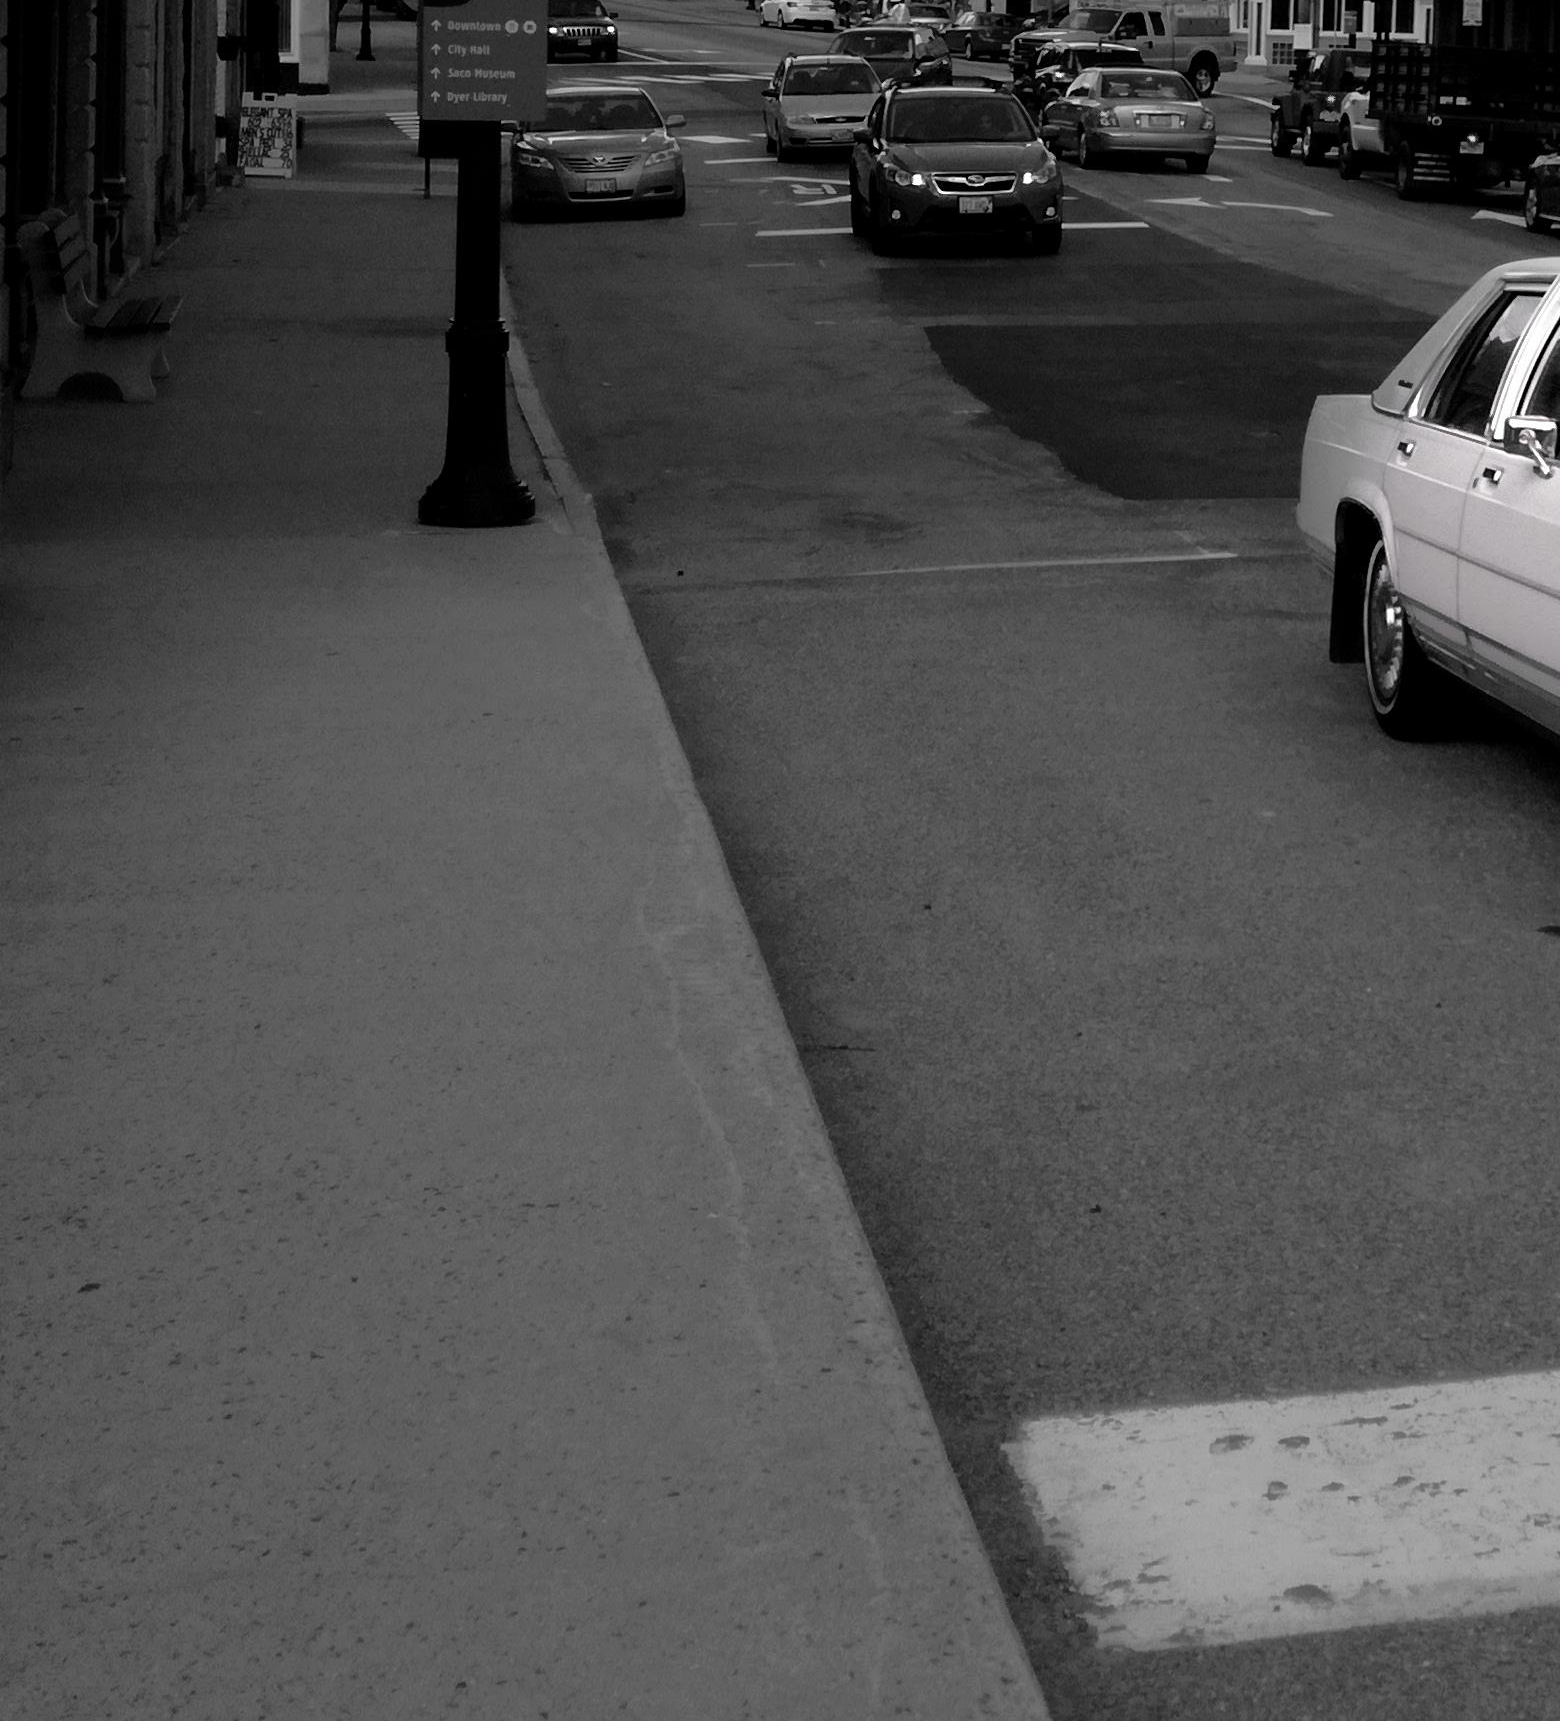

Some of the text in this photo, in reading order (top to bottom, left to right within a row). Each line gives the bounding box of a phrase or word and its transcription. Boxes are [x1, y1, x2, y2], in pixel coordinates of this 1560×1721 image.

[447, 20, 501, 32] Downtown
[447, 44, 490, 57] City Hall
[447, 68, 516, 79] Saco Museum
[447, 91, 507, 104] Dyer Library
